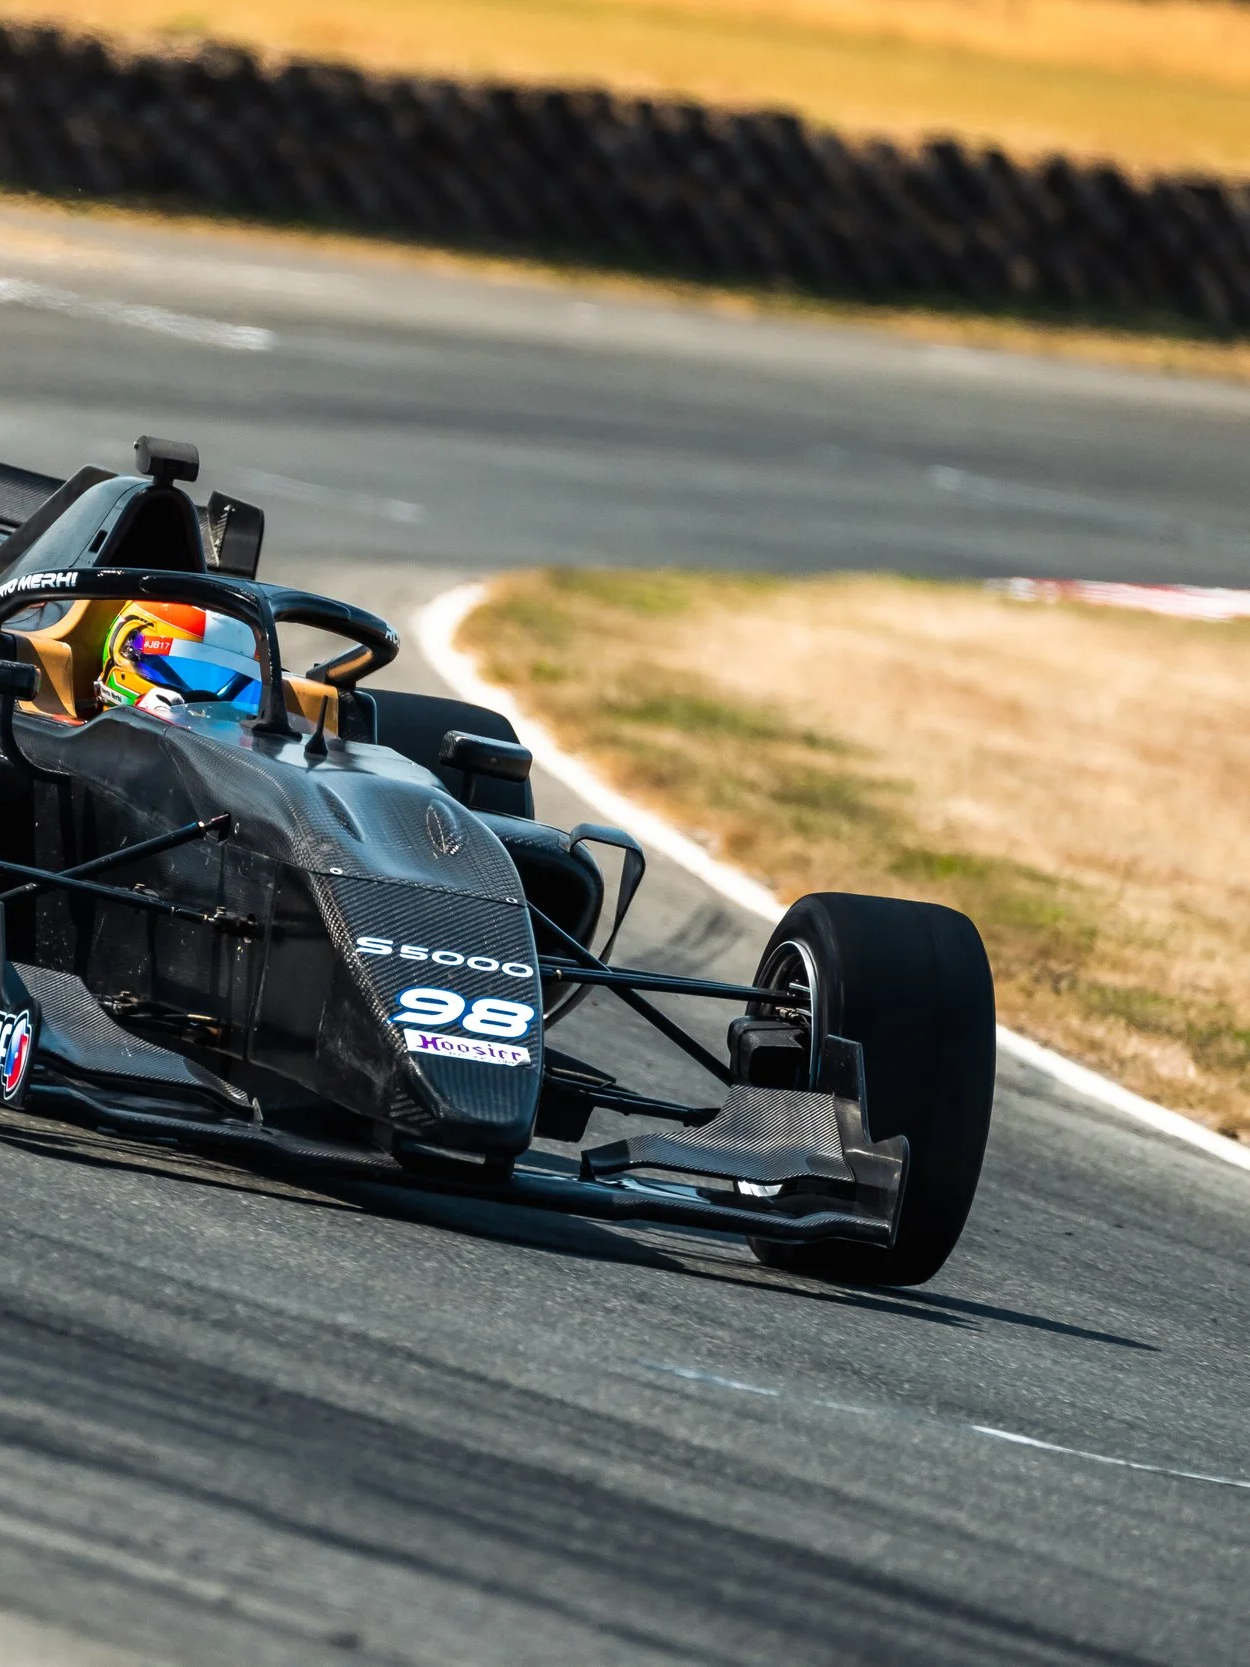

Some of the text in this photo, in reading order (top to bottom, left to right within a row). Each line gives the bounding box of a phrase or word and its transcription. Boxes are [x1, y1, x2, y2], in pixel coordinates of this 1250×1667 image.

[18, 572, 78, 591] MERHI
[143, 640, 171, 650] #JB17
[356, 937, 534, 977] S5000
[391, 987, 536, 1038] 98
